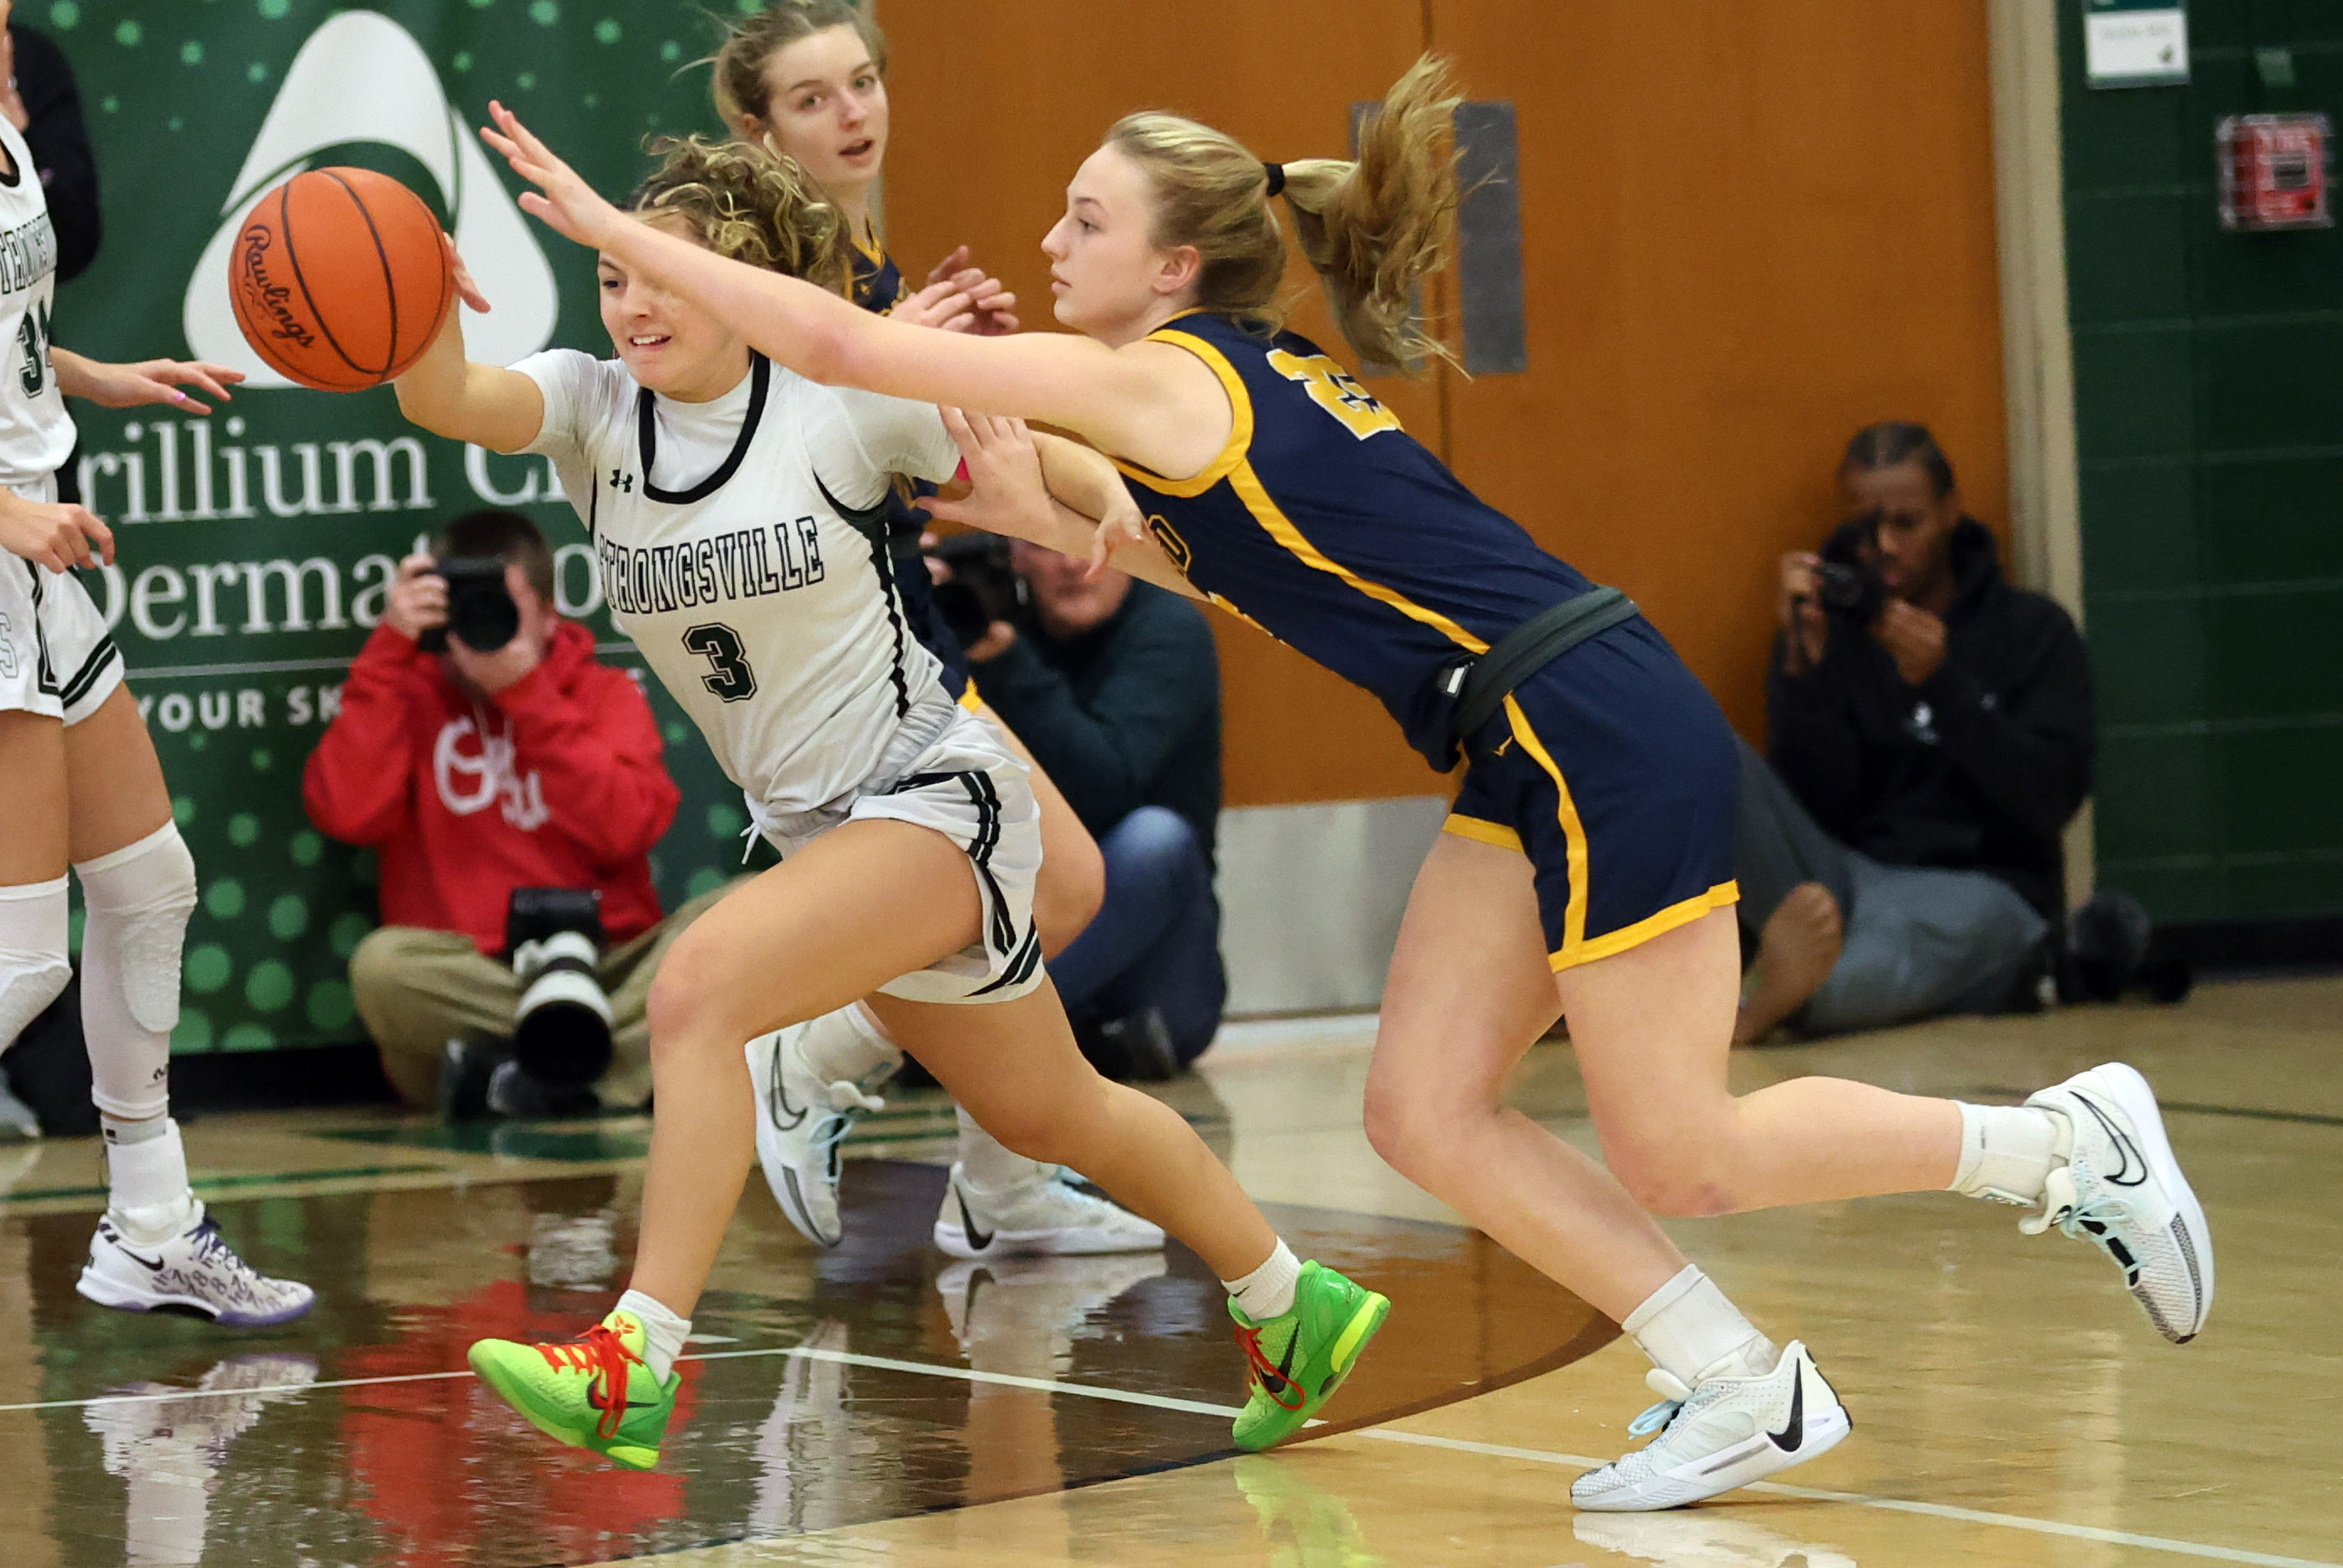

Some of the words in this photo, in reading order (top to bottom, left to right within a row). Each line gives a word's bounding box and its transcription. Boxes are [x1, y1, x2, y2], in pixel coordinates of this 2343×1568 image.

[244, 224, 316, 349] Rawlings
[76, 418, 436, 522] rillium
[286, 684, 343, 727] SK
[681, 623, 758, 703] 3
